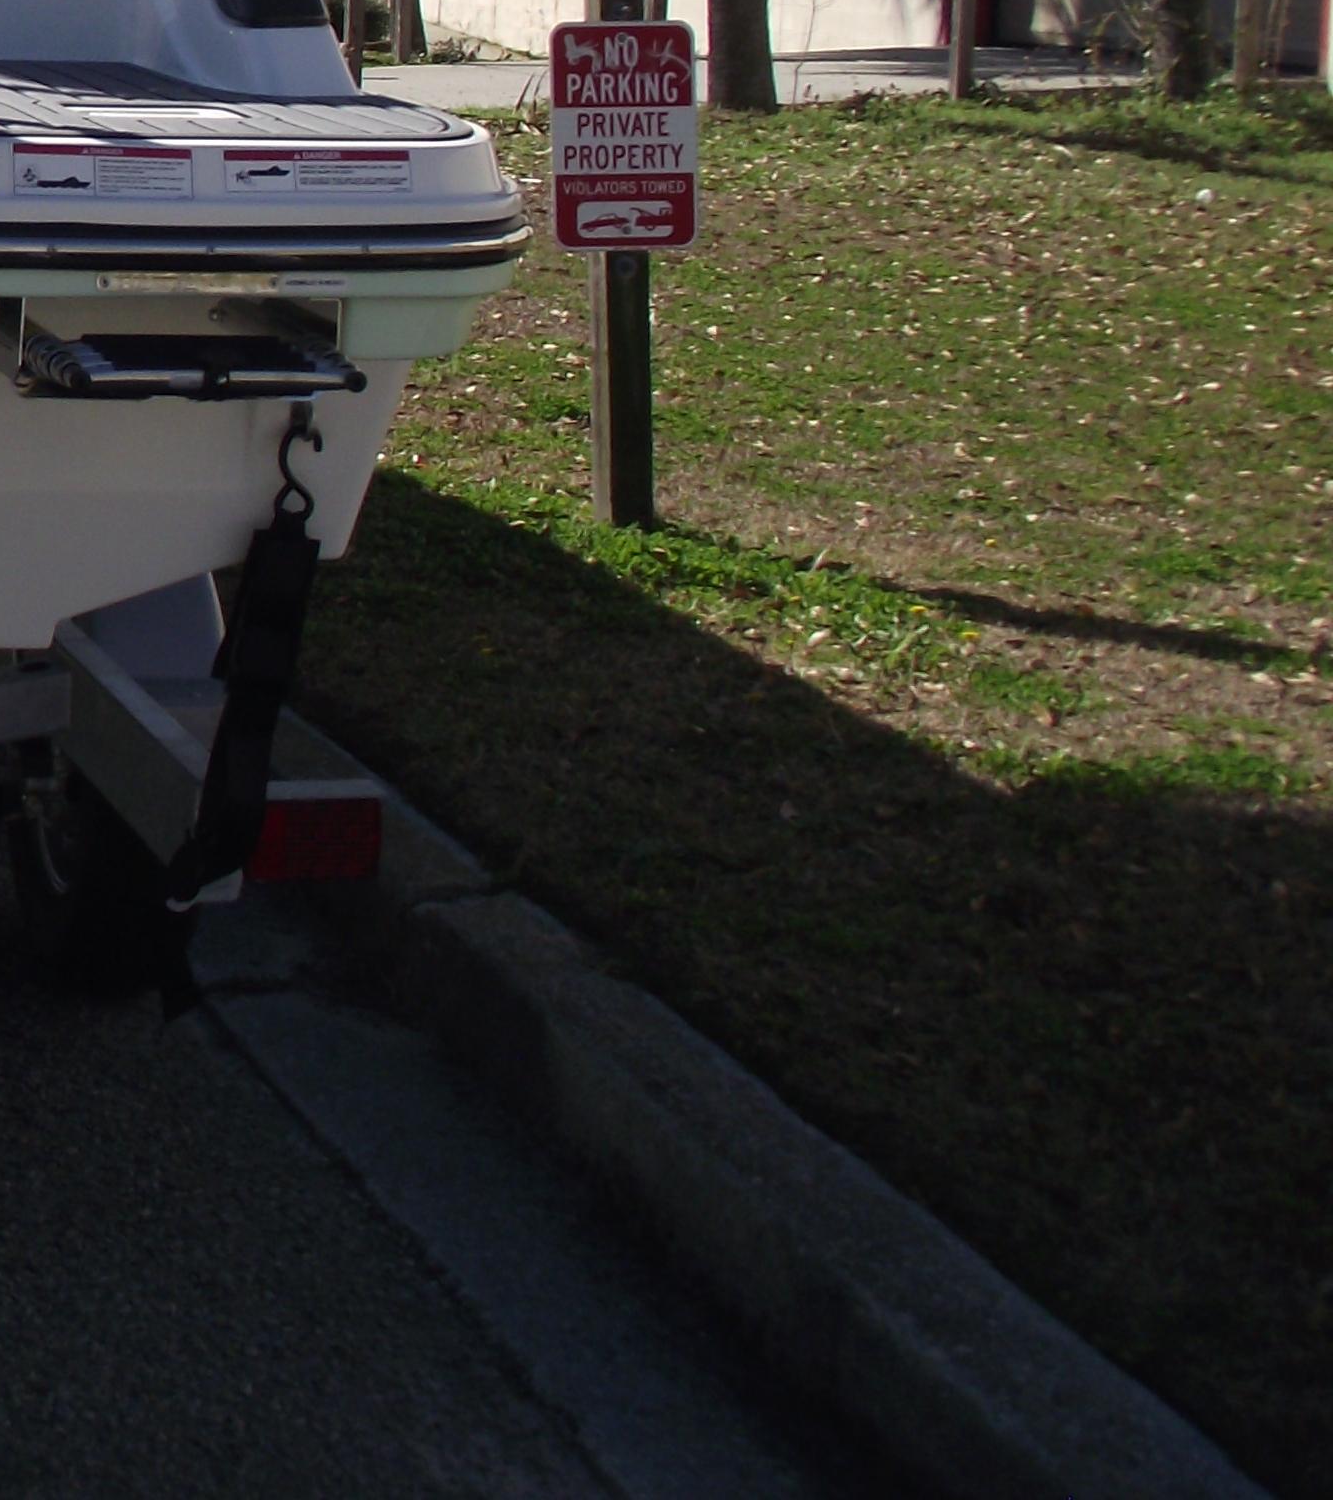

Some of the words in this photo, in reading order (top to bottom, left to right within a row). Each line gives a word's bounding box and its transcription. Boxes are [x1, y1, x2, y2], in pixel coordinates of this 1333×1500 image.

[604, 35, 639, 68] NO
[566, 72, 679, 104] PARKING
[577, 111, 670, 138] PRIVATE
[563, 143, 684, 171] PROPERTY
[563, 180, 637, 196] VIOLATORS
[641, 179, 686, 195] TOWED
